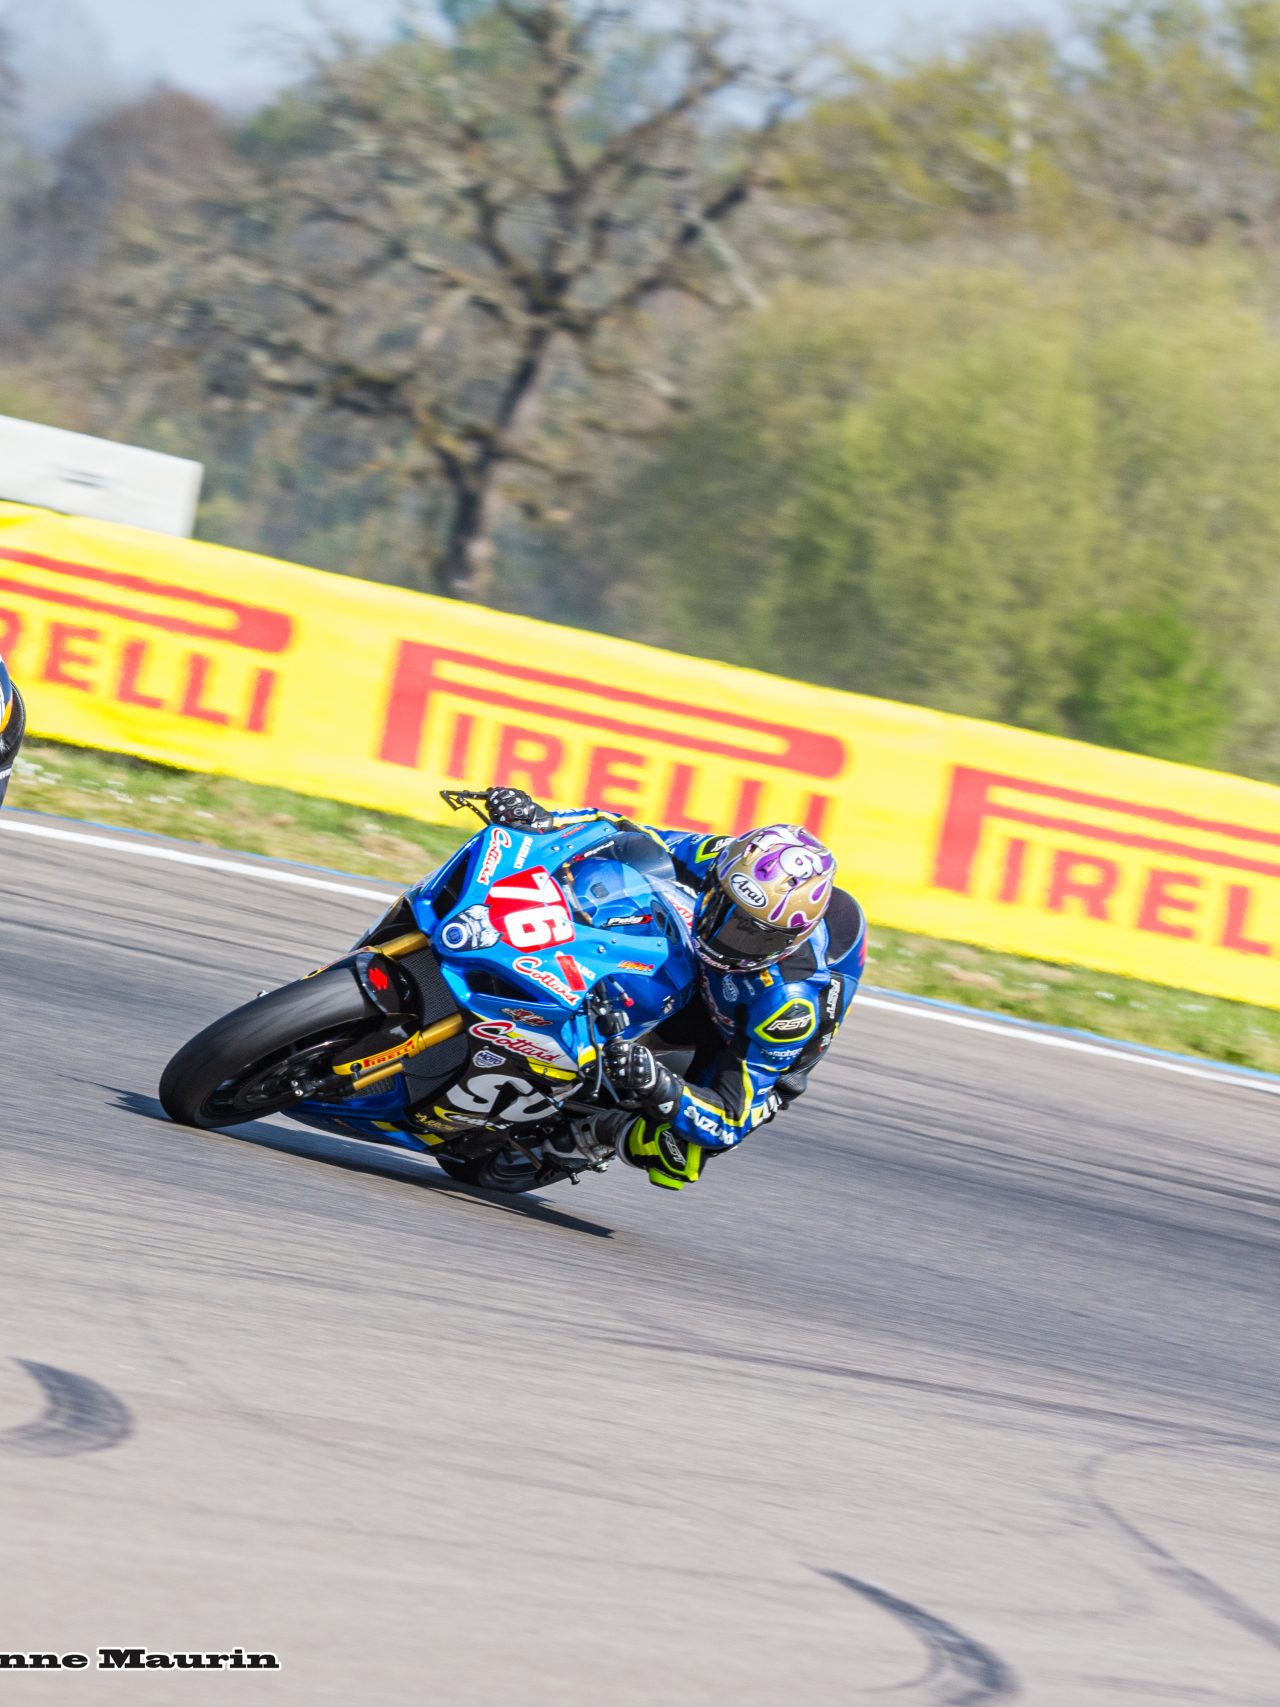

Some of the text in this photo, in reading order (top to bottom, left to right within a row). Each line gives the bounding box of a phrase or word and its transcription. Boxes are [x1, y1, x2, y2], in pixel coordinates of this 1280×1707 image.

[478, 827, 511, 885] Cottard
[931, 764, 1280, 956] PIREL
[488, 872, 574, 948] 76
[731, 879, 764, 904] Arai
[514, 957, 580, 1005] Cottard
[471, 1021, 562, 1063] Cottard
[766, 1015, 813, 1031] RST
[363, 1040, 415, 1068] PIRELLI
